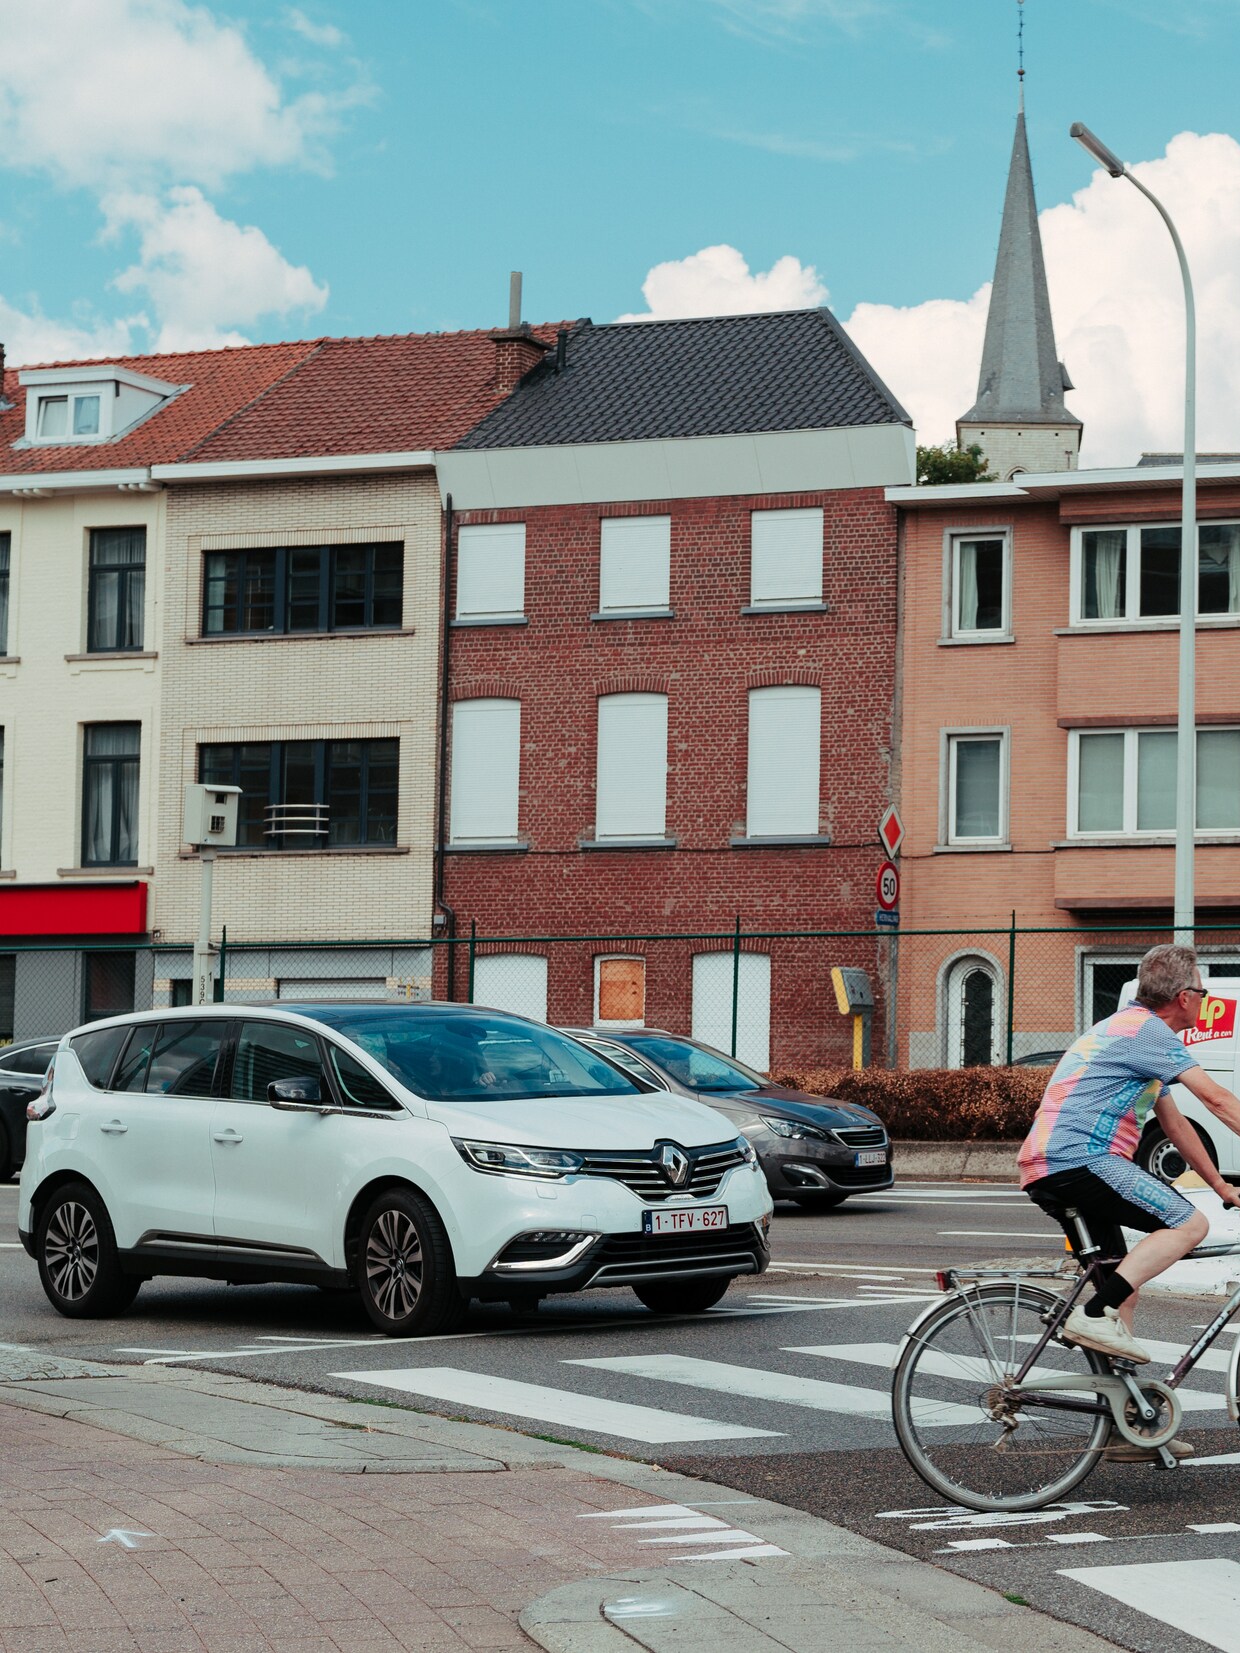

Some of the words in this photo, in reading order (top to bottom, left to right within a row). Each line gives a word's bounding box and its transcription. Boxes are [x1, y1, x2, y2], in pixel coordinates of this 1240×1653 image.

[883, 877, 896, 896] 50
[1186, 1026, 1213, 1043] Rent
[1134, 1181, 1170, 1208] CERA
[645, 1223, 651, 1231] B
[655, 1210, 724, 1230] 1-TFV-627
